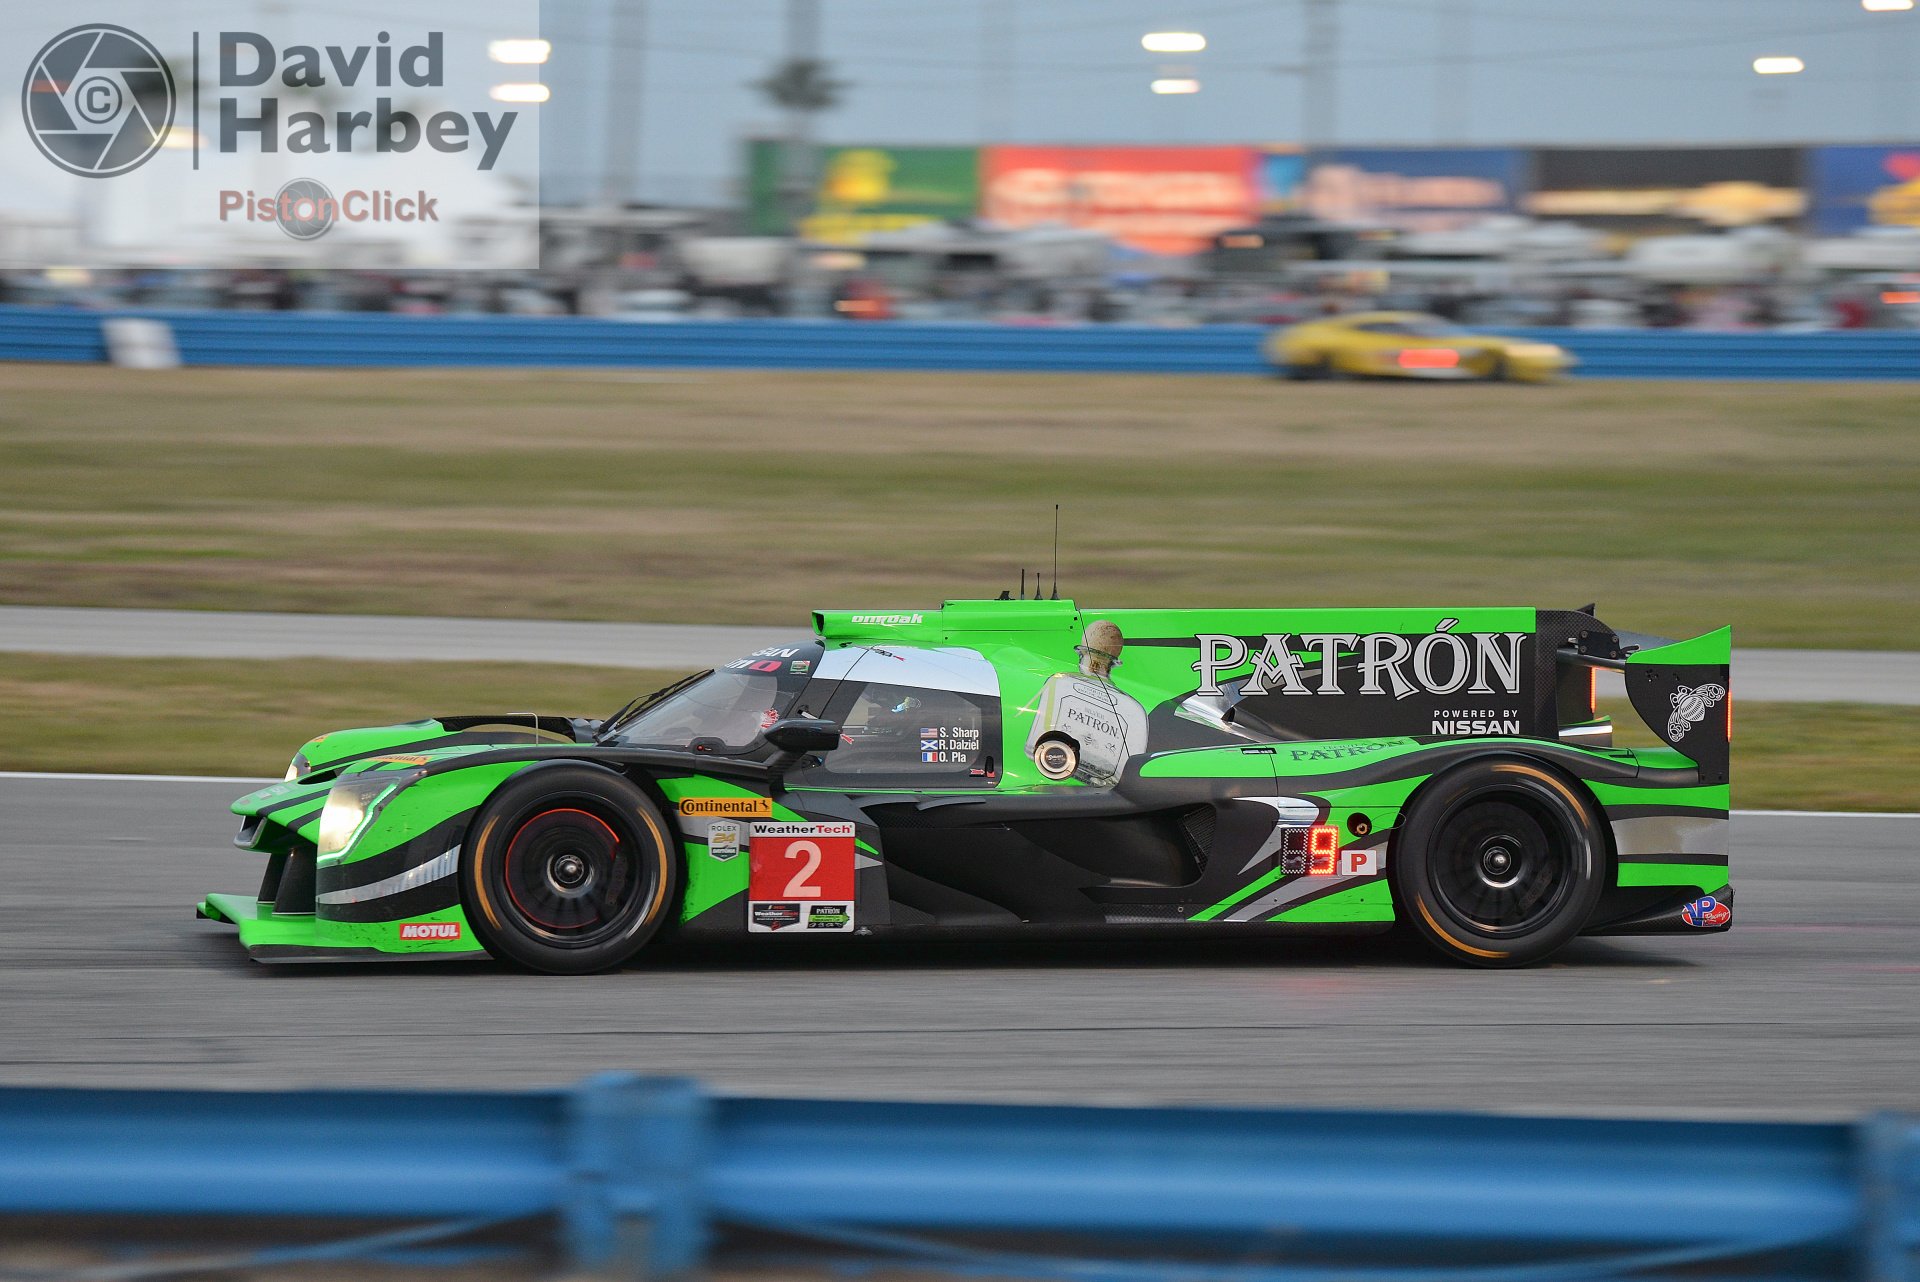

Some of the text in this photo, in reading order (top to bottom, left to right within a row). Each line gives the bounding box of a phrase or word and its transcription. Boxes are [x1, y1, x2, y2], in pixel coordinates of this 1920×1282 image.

[1191, 618, 1526, 700] PATRÓN
[1433, 710, 1519, 718] POWERED BY
[1067, 708, 1118, 737] PATRÓN
[1431, 720, 1520, 735] NISSAN
[939, 727, 979, 740] S. Sharp
[939, 739, 979, 750] R. Dalziel
[938, 751, 967, 763] O. Pla
[680, 799, 758, 815] Continental
[754, 825, 851, 834] WeatherTech
[712, 832, 737, 844] 24
[782, 840, 822, 898] 2
[1350, 853, 1368, 873] P
[1682, 896, 1717, 927] VP
[402, 925, 458, 938] MOTUL
